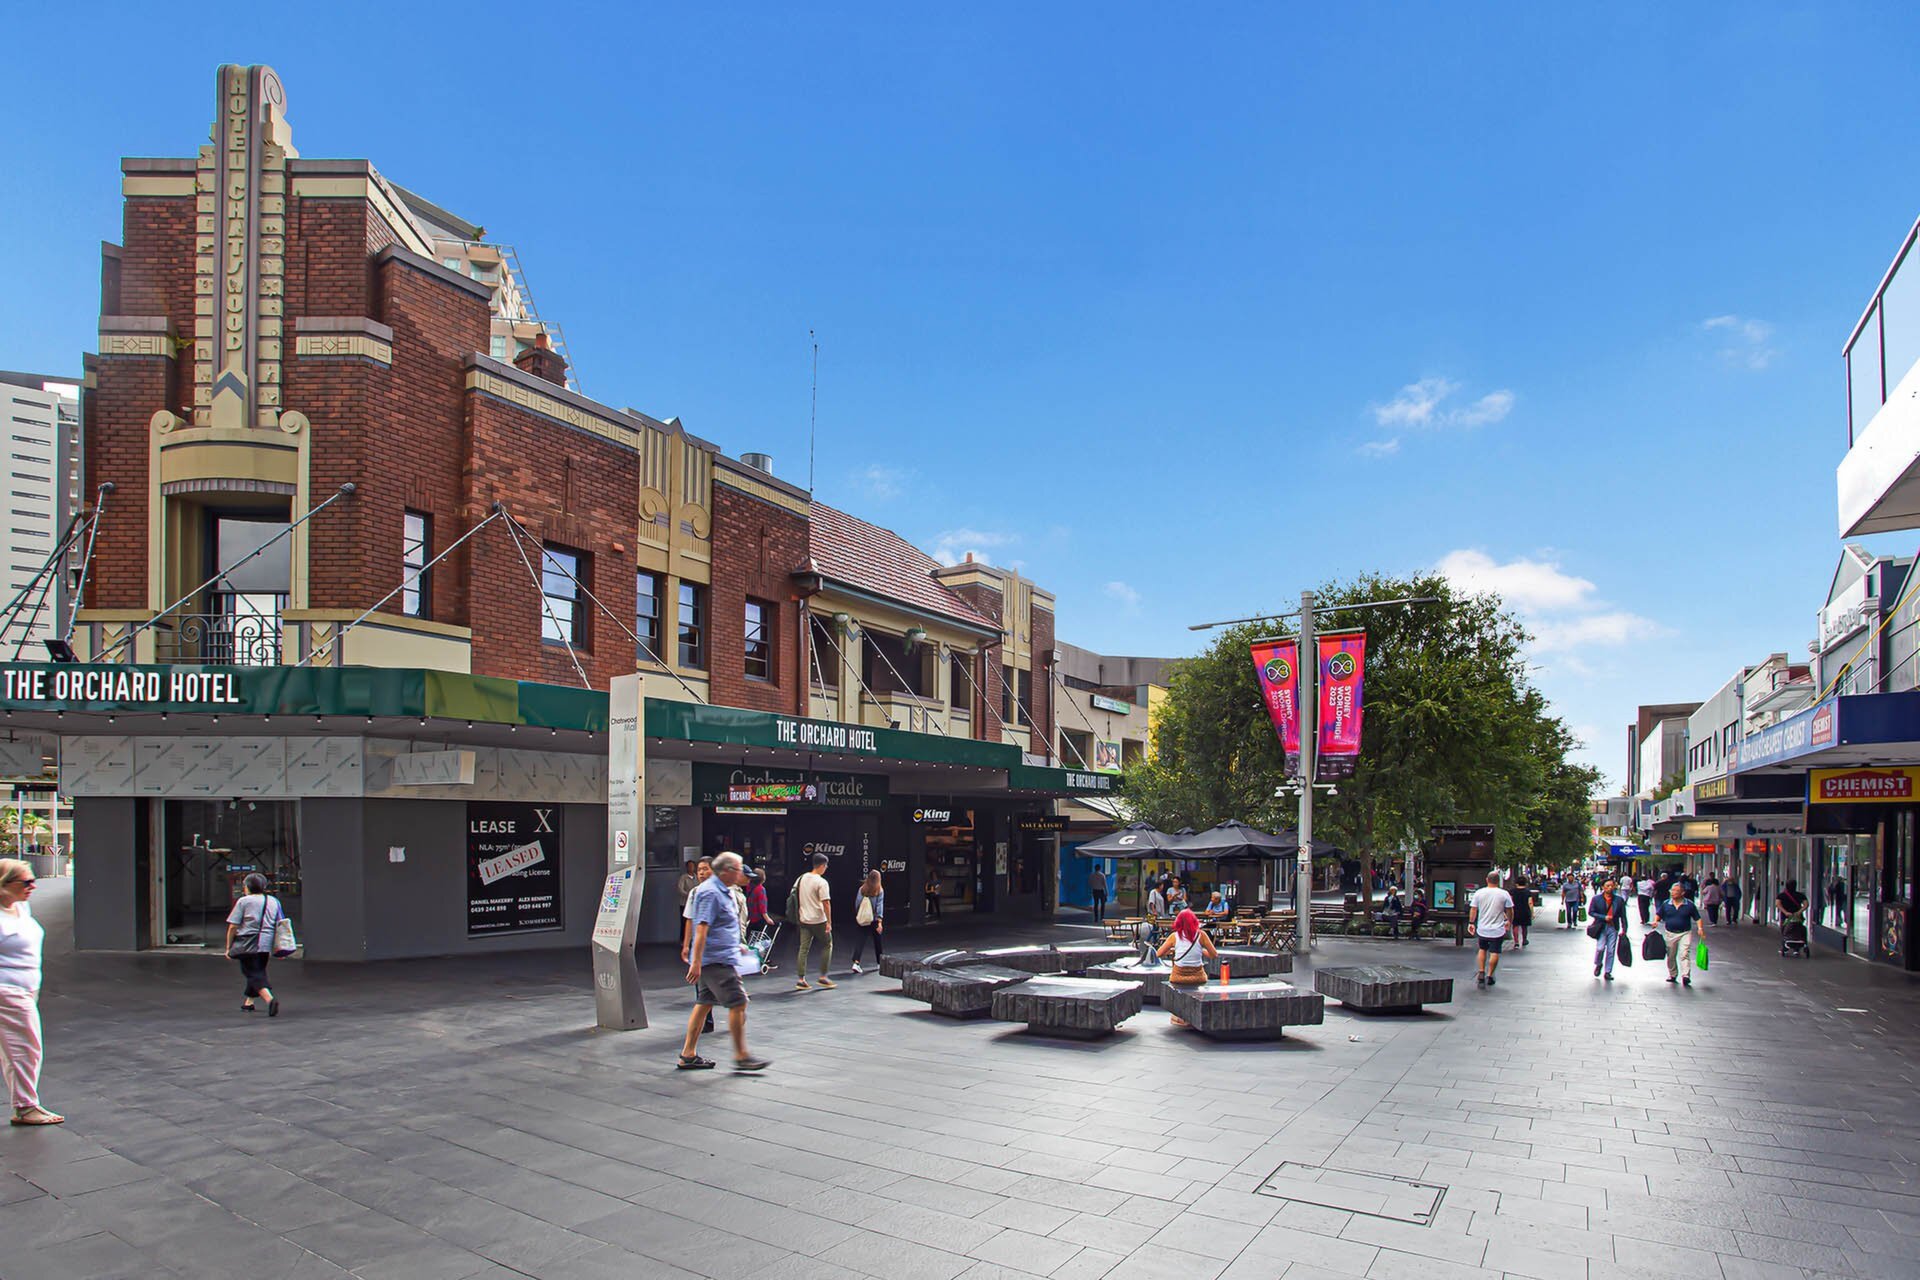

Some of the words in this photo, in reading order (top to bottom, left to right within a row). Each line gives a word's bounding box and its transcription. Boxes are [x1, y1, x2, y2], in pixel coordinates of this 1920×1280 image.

[4, 670, 46, 700] THE
[55, 671, 160, 702] ORCHARD
[170, 672, 239, 703] HOTEL
[1329, 686, 1337, 706] 2023
[1271, 690, 1280, 710] 2023
[1284, 688, 1293, 720] SYDNEY
[1343, 685, 1352, 719] SYDNEY
[1277, 689, 1288, 742] WORLDPRIDE
[1333, 686, 1345, 740] WORLDPRIDE
[1812, 715, 1831, 735] CHEMIST
[776, 720, 797, 743] THE
[800, 723, 846, 747] ORCHARD
[849, 728, 877, 751] HOTEL
[1066, 772, 1076, 787] THE
[1076, 774, 1097, 788] ORCHARD
[1825, 777, 1907, 791] CHEMIST
[1826, 789, 1907, 797] WAREHOUSE
[533, 808, 554, 833] X
[924, 809, 951, 822] King
[471, 820, 516, 834] LEASE
[814, 843, 846, 857] King
[484, 846, 540, 878] LEASED
[529, 868, 551, 876] License
[887, 859, 907, 873] King
